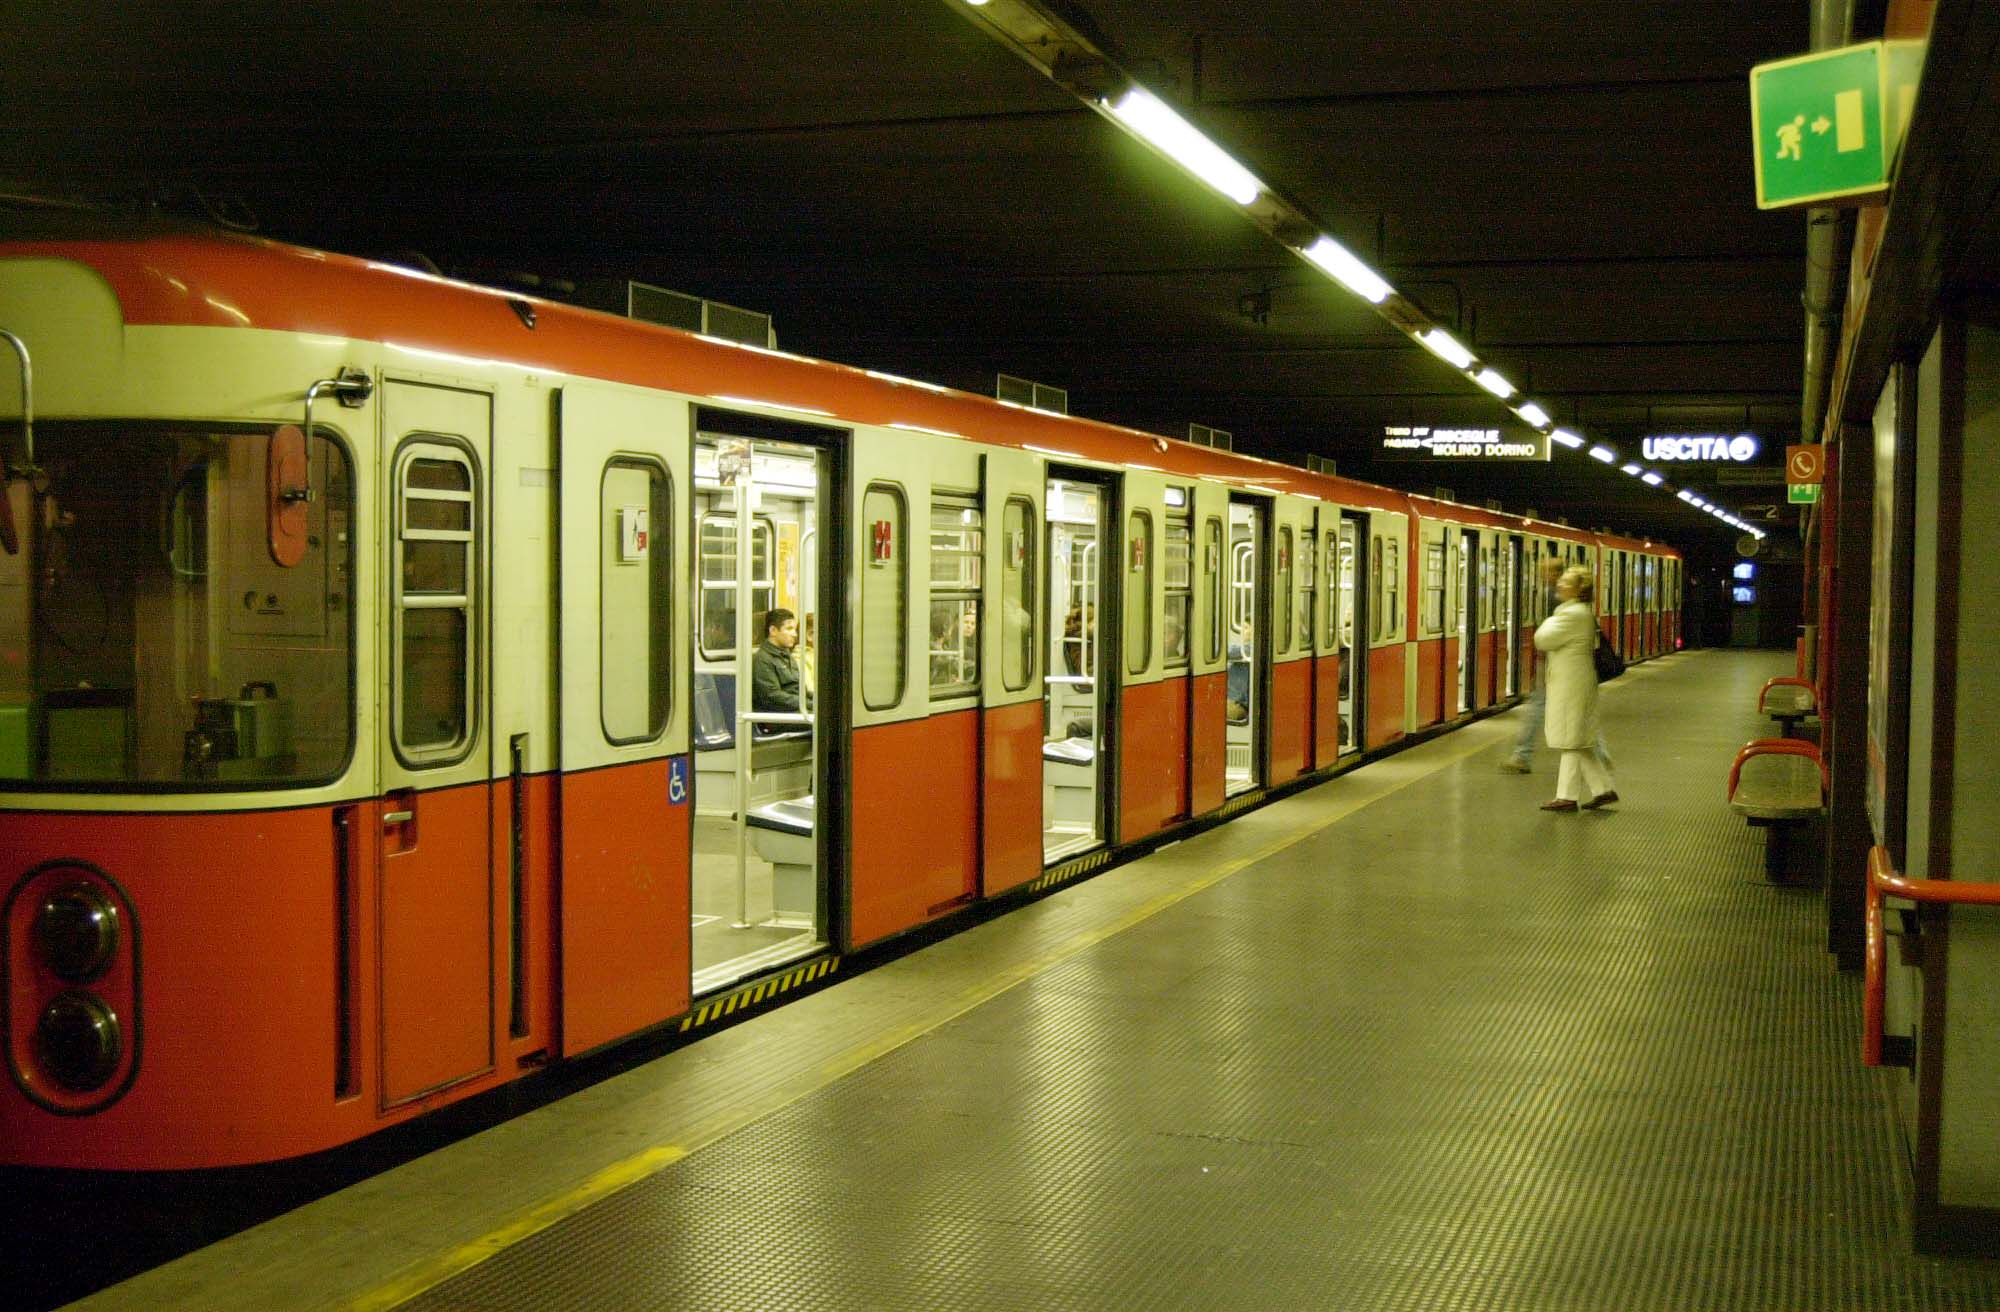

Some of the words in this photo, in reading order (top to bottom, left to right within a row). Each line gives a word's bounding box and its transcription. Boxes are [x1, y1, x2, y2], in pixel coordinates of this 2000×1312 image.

[1433, 443, 1482, 456] MOLINO
[1485, 443, 1536, 456] DORINO
[1642, 437, 1730, 460] USCITA
